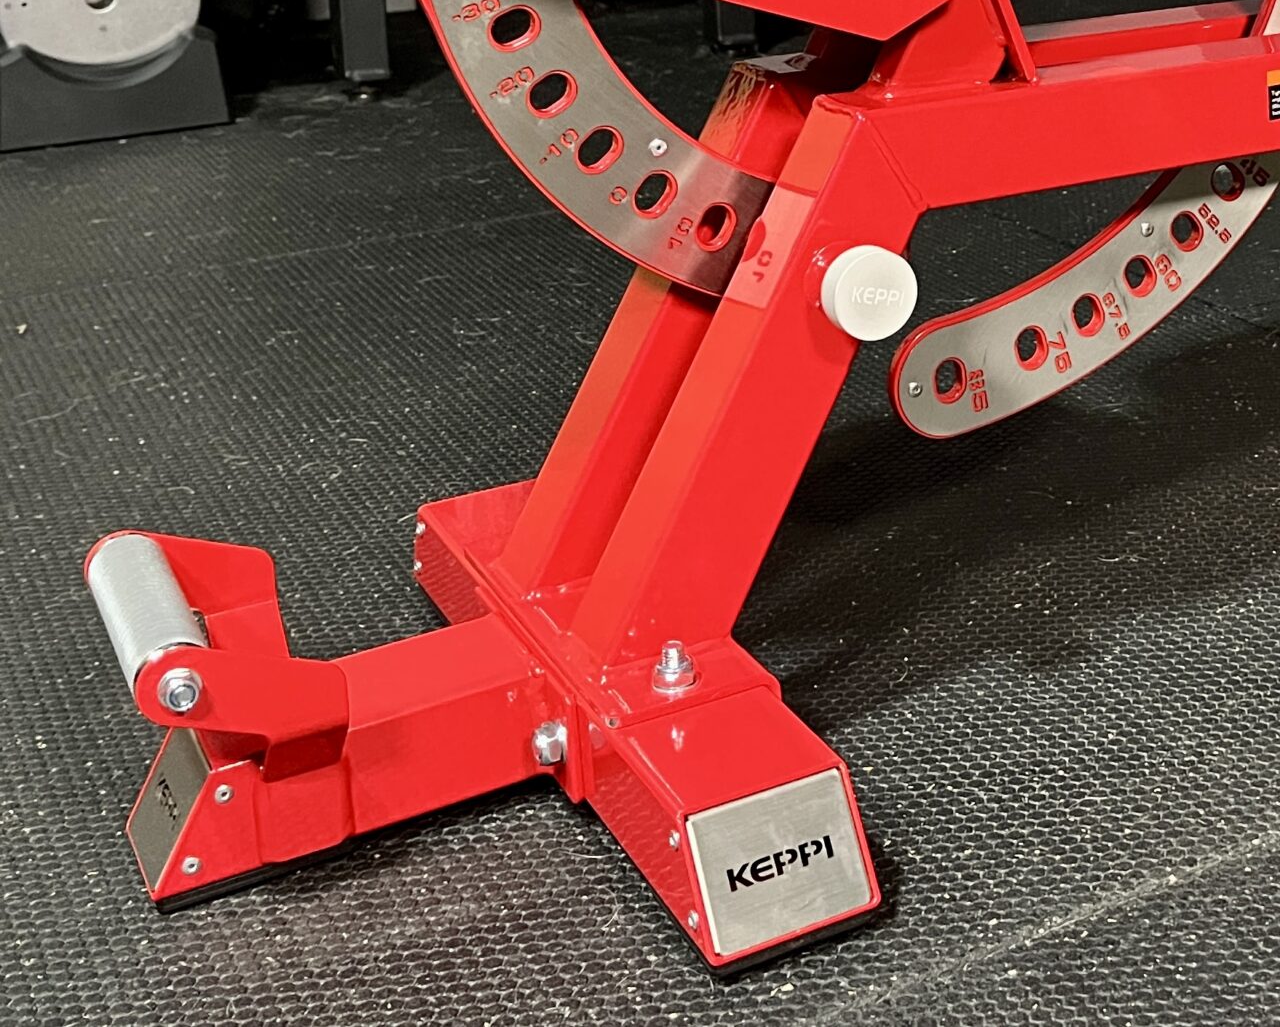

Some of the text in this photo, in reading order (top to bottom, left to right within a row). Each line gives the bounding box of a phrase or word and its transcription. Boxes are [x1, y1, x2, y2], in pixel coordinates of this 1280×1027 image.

[489, 66, 535, 99] -20
[539, 128, 579, 164] -10
[1240, 159, 1270, 187] 45
[608, 186, 628, 206] 0
[668, 217, 694, 250] 10
[1198, 203, 1232, 244] 52.5
[1155, 254, 1182, 292] 60
[851, 286, 905, 307] KEPPI
[1102, 292, 1131, 340] 67.5
[1049, 331, 1072, 374] 75
[726, 835, 834, 892] KEPPI
